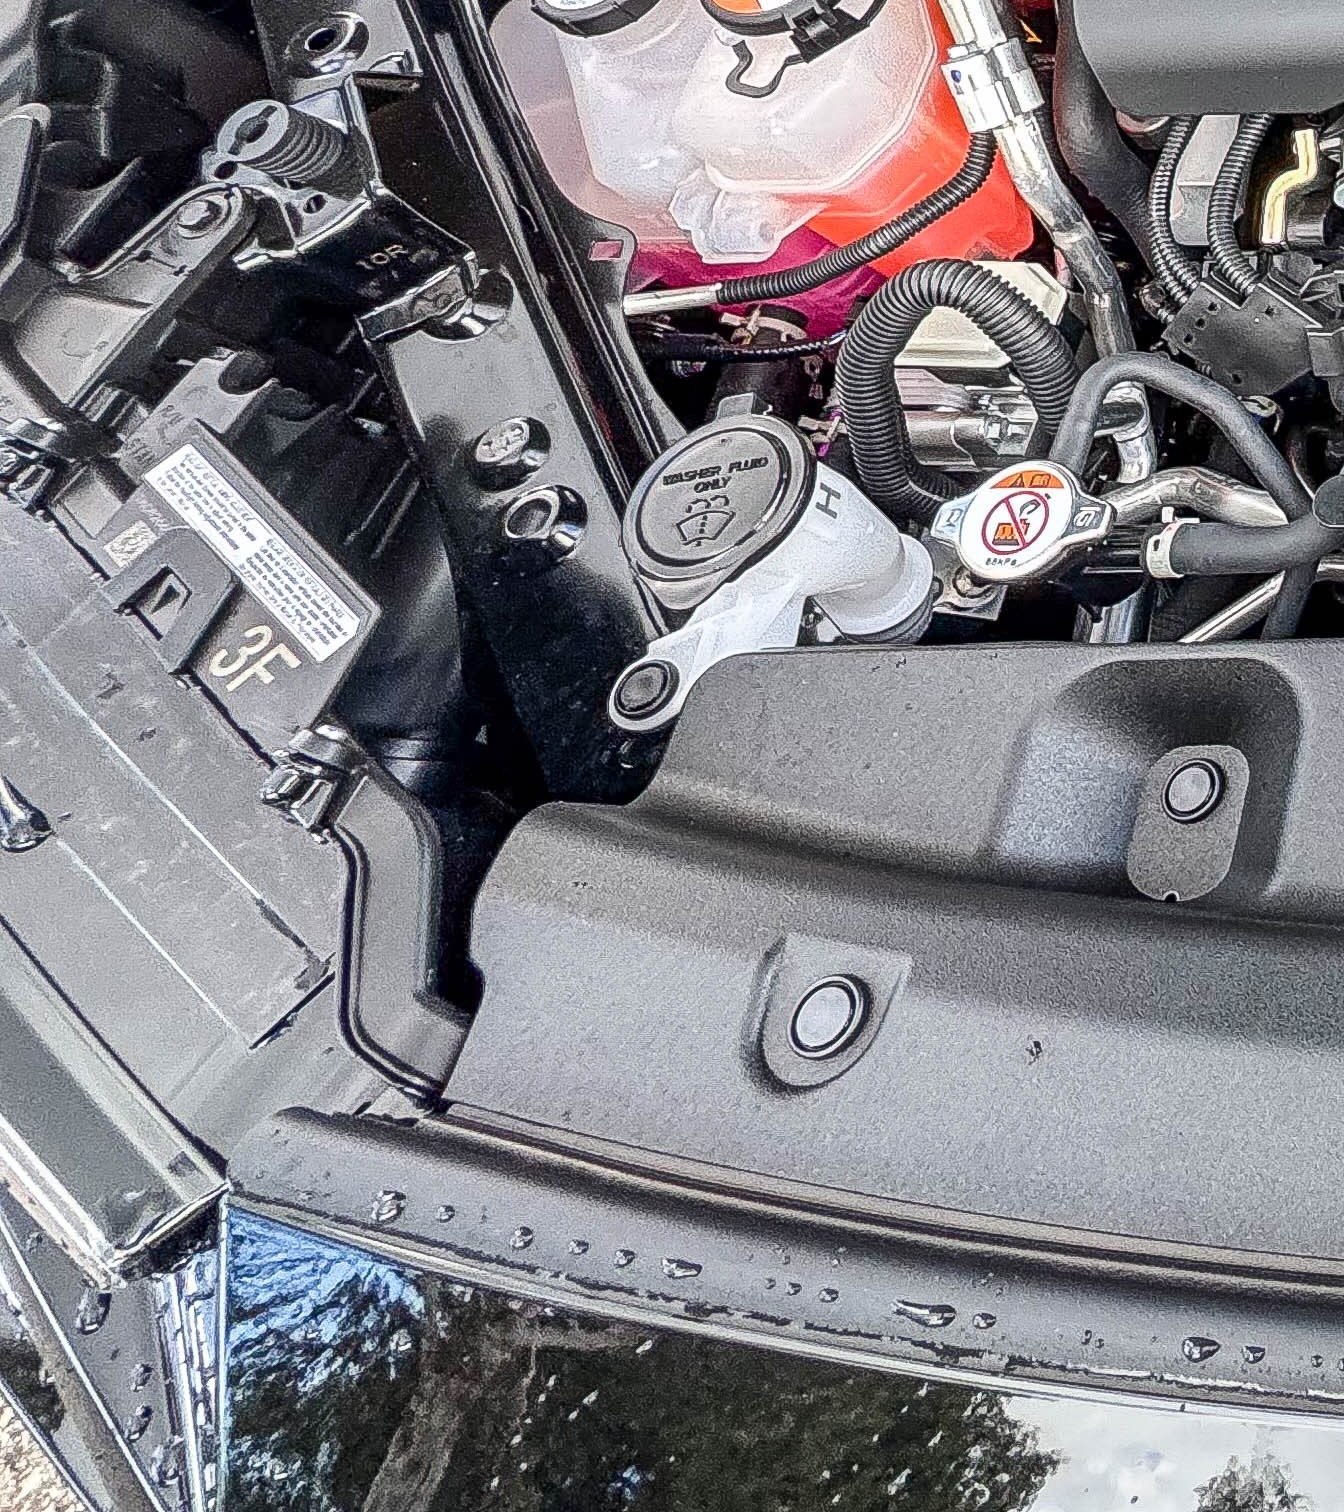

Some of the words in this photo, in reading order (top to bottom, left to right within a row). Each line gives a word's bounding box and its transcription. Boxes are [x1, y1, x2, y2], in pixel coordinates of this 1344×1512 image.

[663, 465, 722, 486] WASHER
[728, 456, 769, 474] FLUID
[693, 475, 732, 494] ONLY
[208, 624, 302, 693] 3F
